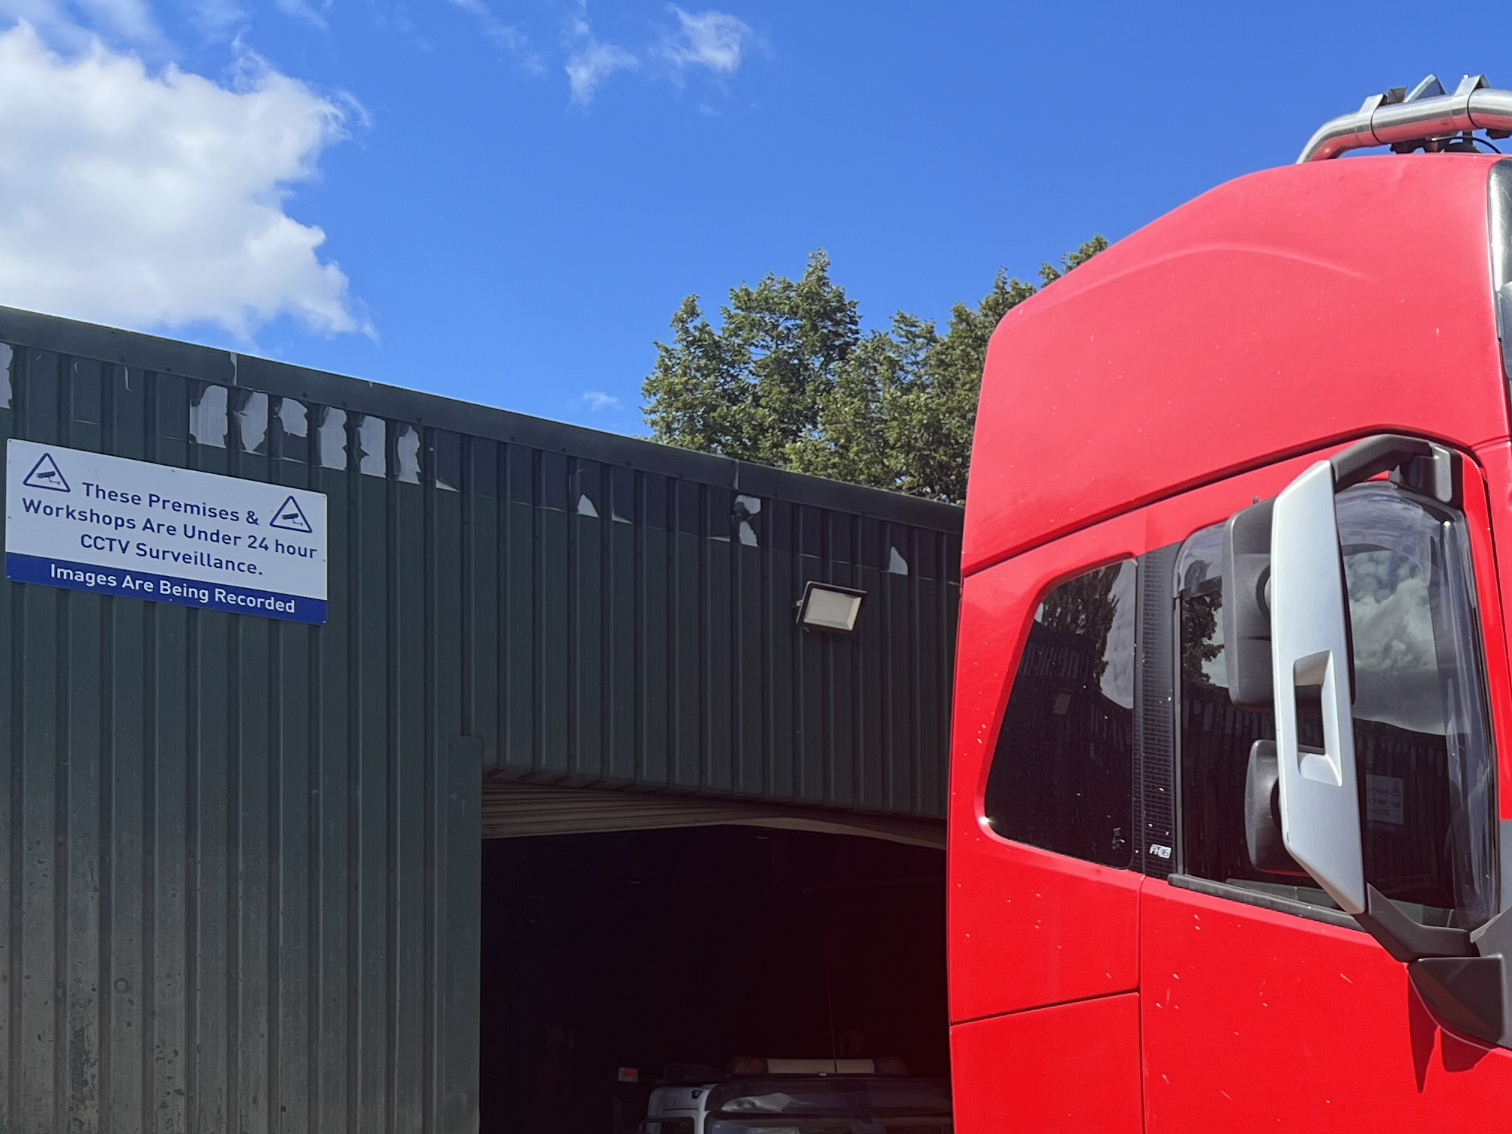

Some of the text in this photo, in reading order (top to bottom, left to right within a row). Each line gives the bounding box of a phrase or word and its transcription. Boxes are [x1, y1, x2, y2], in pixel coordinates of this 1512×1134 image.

[82, 482, 260, 525] These Premises &
[22, 497, 318, 560] Workshops Are Under 24 hour
[80, 534, 264, 576] CCTV Surveillance.
[50, 563, 296, 614] Images Are Being Recorded
